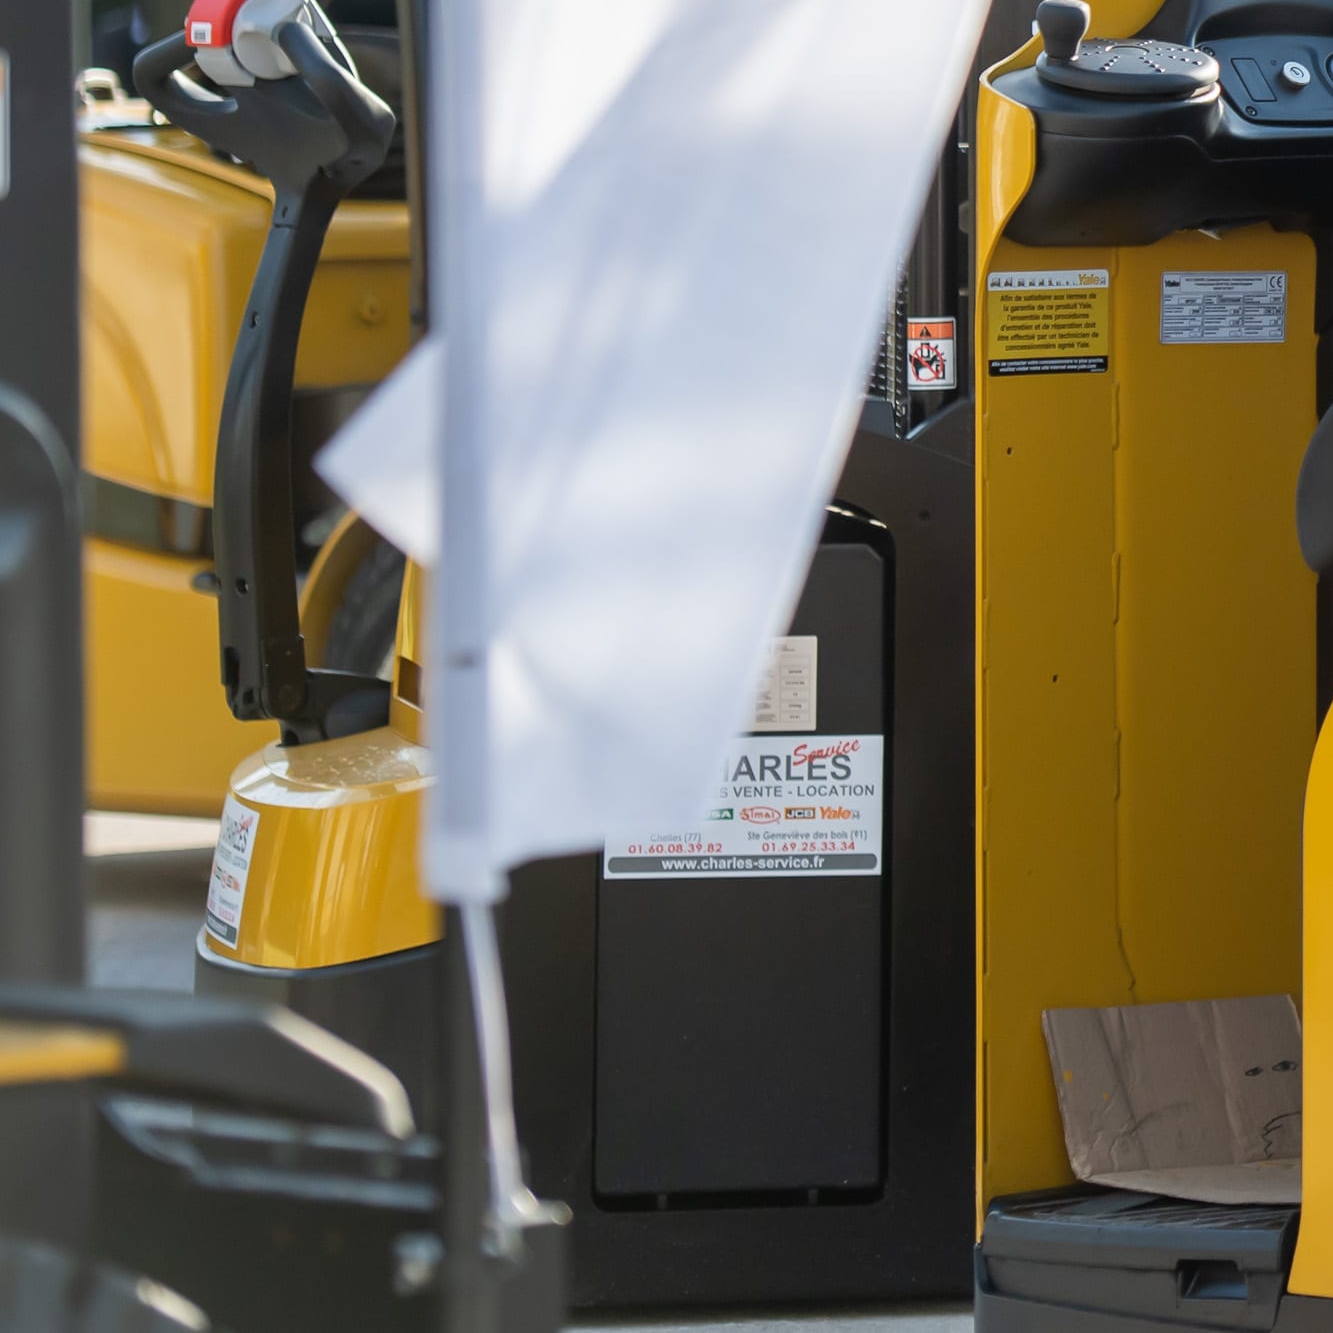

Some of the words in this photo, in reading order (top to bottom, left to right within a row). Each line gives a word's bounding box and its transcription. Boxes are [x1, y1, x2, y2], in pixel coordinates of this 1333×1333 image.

[1078, 273, 1100, 286] Yale
[1037, 303, 1044, 311] de
[1042, 322, 1049, 330] de
[792, 738, 861, 767] Service
[733, 784, 783, 798] VENTE
[796, 784, 875, 797] LOCATION
[786, 808, 814, 819] JCB
[819, 806, 853, 820] Yale
[684, 832, 702, 844] (77)
[747, 831, 762, 841] Ste
[764, 830, 814, 841] Geneviève
[815, 830, 829, 840] des
[830, 829, 849, 840] bois
[850, 829, 868, 842] (91)
[628, 842, 723, 854] 01.60.08.39.82
[762, 840, 856, 853] 01.69.25.33.34
[660, 855, 825, 872] www.charles-service.fr
